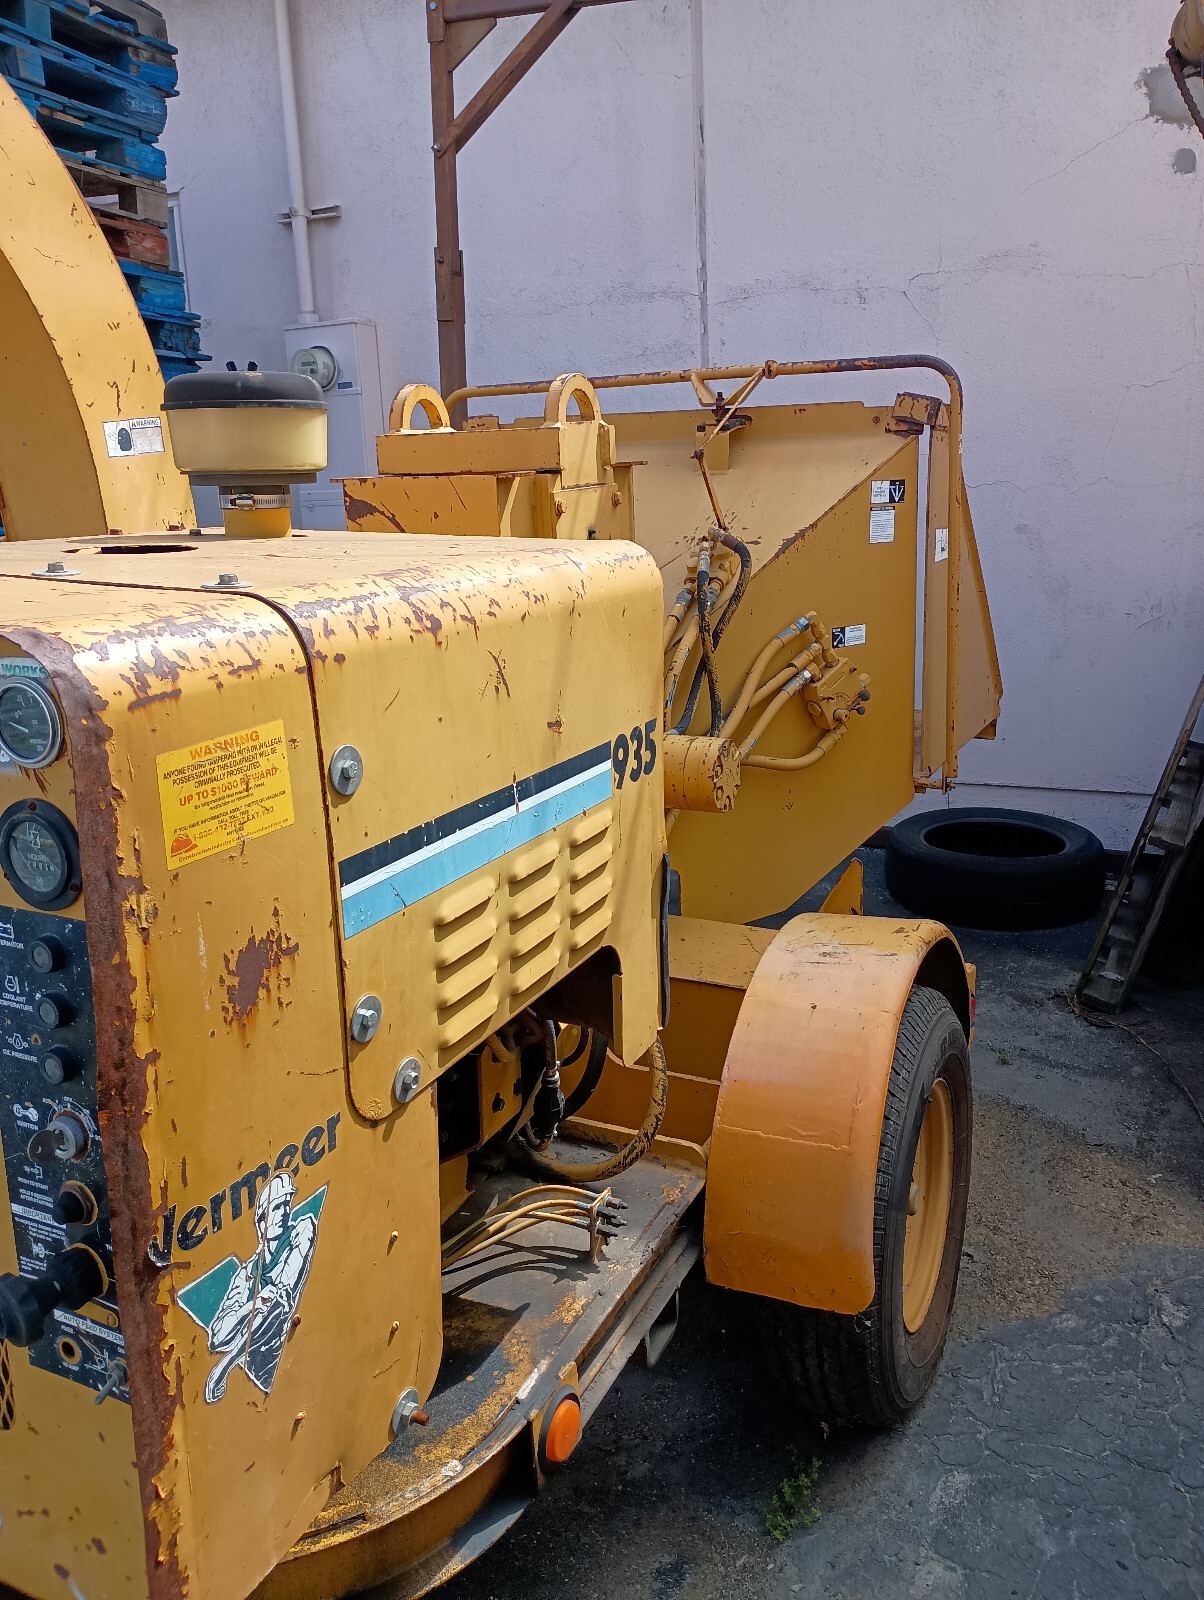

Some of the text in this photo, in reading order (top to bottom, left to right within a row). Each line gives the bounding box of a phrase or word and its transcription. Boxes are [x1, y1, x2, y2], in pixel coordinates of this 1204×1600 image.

[136, 418, 160, 427] WARNING
[1, 663, 48, 680] WORKS
[189, 730, 260, 761] WARNING
[612, 717, 657, 790] 935
[163, 765, 187, 781] ANYONE
[186, 760, 207, 774] FOUND
[207, 750, 238, 768] TAMPERING
[250, 743, 260, 753] OR
[264, 736, 284, 750] ILLEGAL
[172, 746, 278, 787] POSSESSION OF THIS EQUIPMENT WILL BE
[178, 766, 278, 807] UP TO $1000 REWARD
[194, 772, 227, 789] CRIMINALLY
[177, 824, 189, 833] YOU
[190, 820, 202, 829] HAVE
[200, 810, 229, 825] INFORMATION
[229, 806, 243, 817] ABOUT
[217, 816, 229, 825] CALL
[27, 852, 46, 863] HOURS
[178, 847, 212, 862] Construction
[211, 838, 232, 852] Industry
[2, 992, 26, 1003] COOLANT
[3, 1048, 39, 1063] OIL PRESSURE
[17, 1119, 39, 1131] IGNITION
[63, 1314, 124, 1344] AUTO FEED SYSTEM
